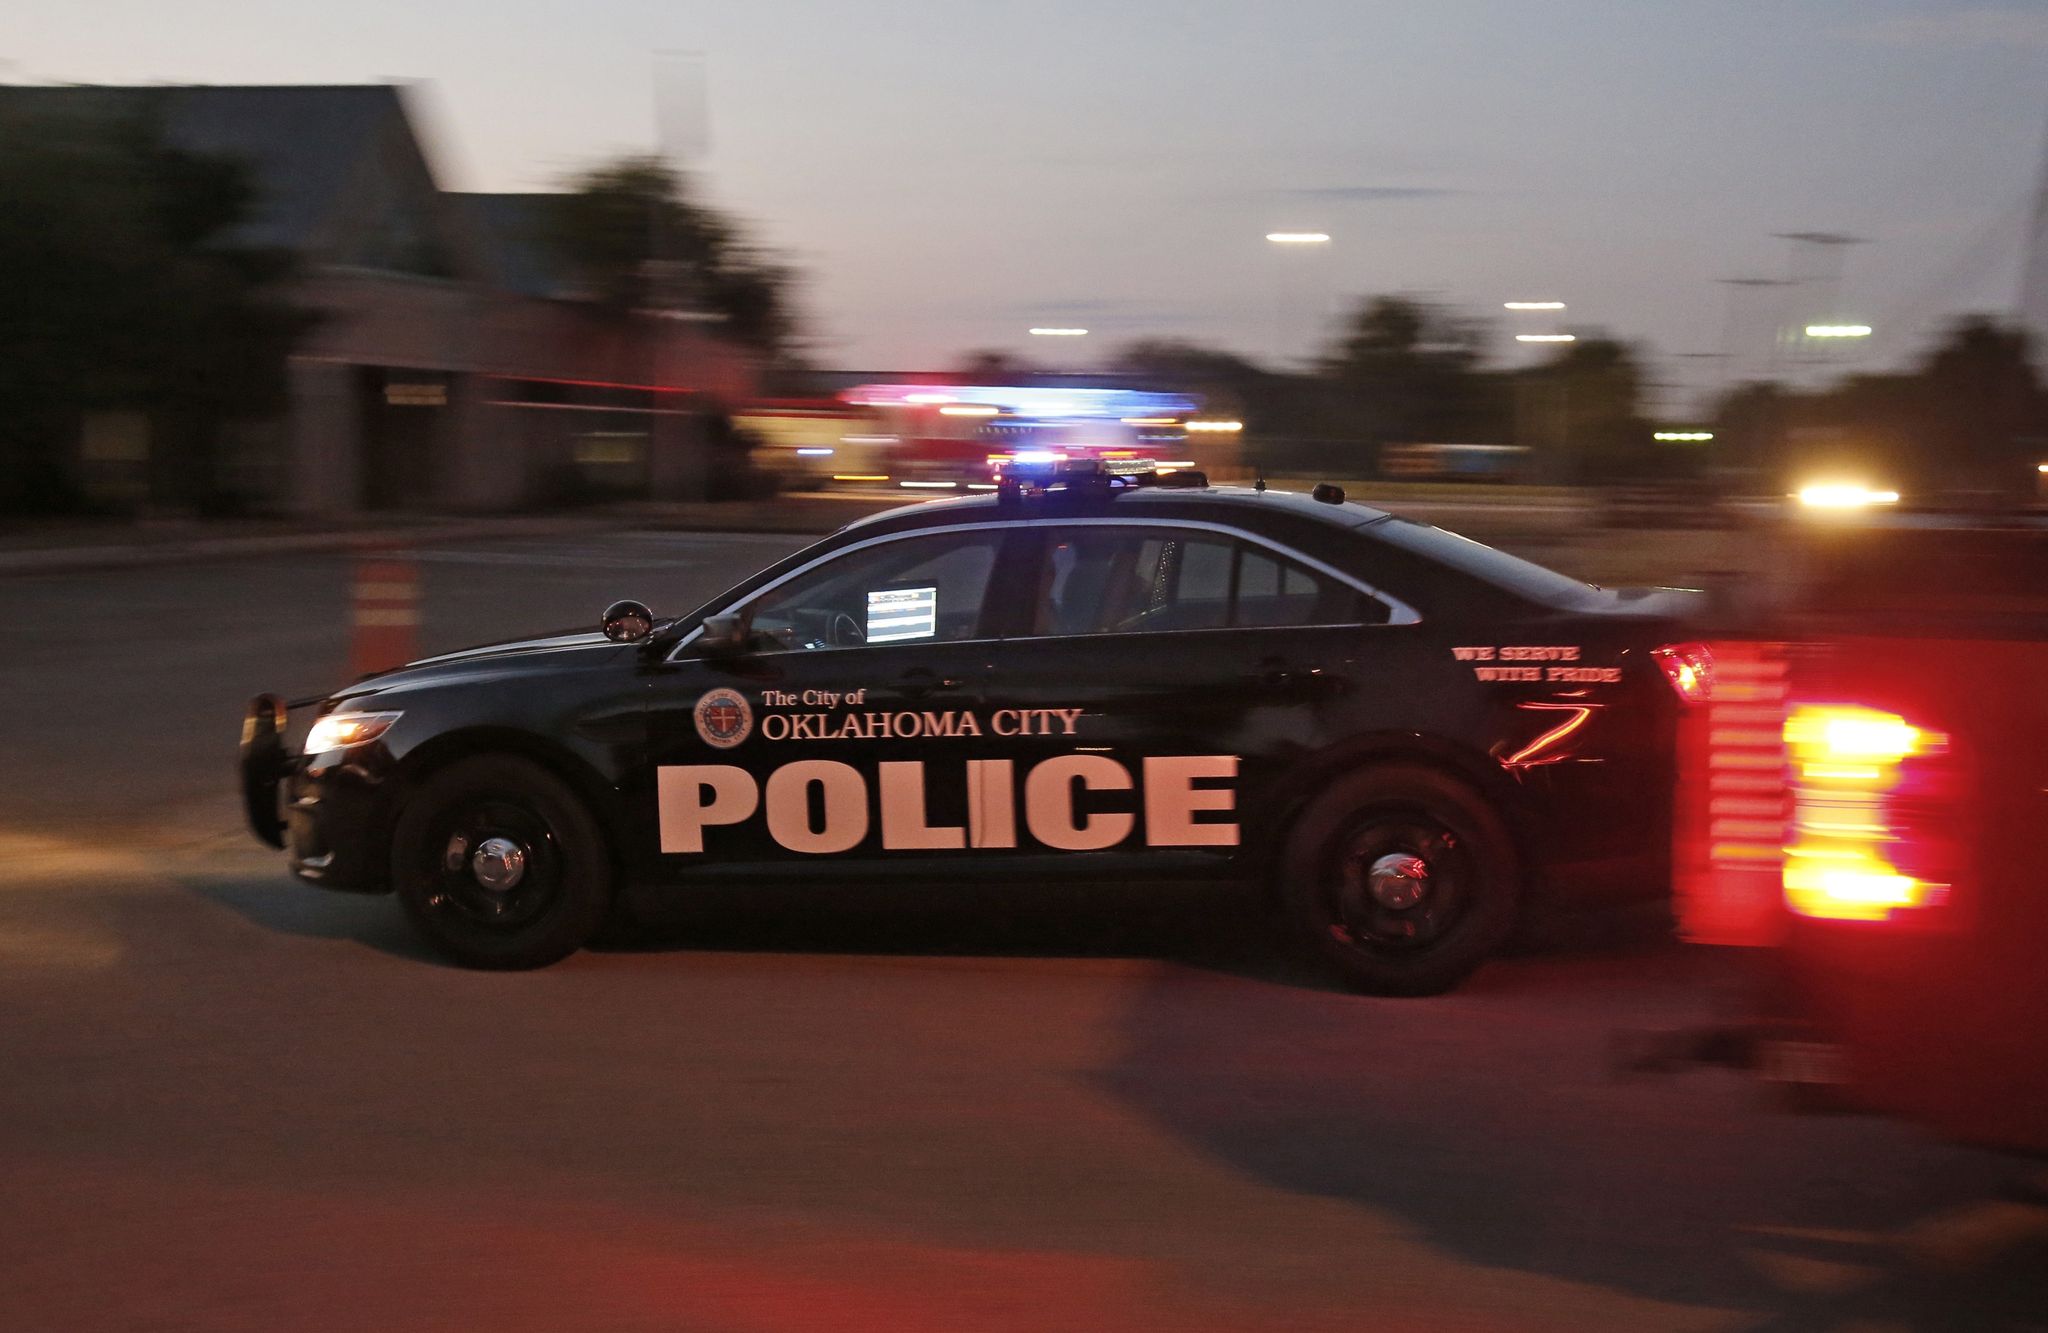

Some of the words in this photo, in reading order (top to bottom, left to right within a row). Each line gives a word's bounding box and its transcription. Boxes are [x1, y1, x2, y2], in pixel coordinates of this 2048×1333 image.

[1452, 647, 1495, 660] WE
[1499, 646, 1580, 660] SERVE
[1475, 667, 1541, 681] WITH
[1546, 668, 1621, 682] PRIDE
[762, 690, 797, 706] The
[803, 689, 839, 709] City
[844, 688, 866, 705] of
[762, 711, 982, 739] OKLAHOMA
[991, 709, 1083, 736] CITY
[657, 754, 1240, 853] POLICE
